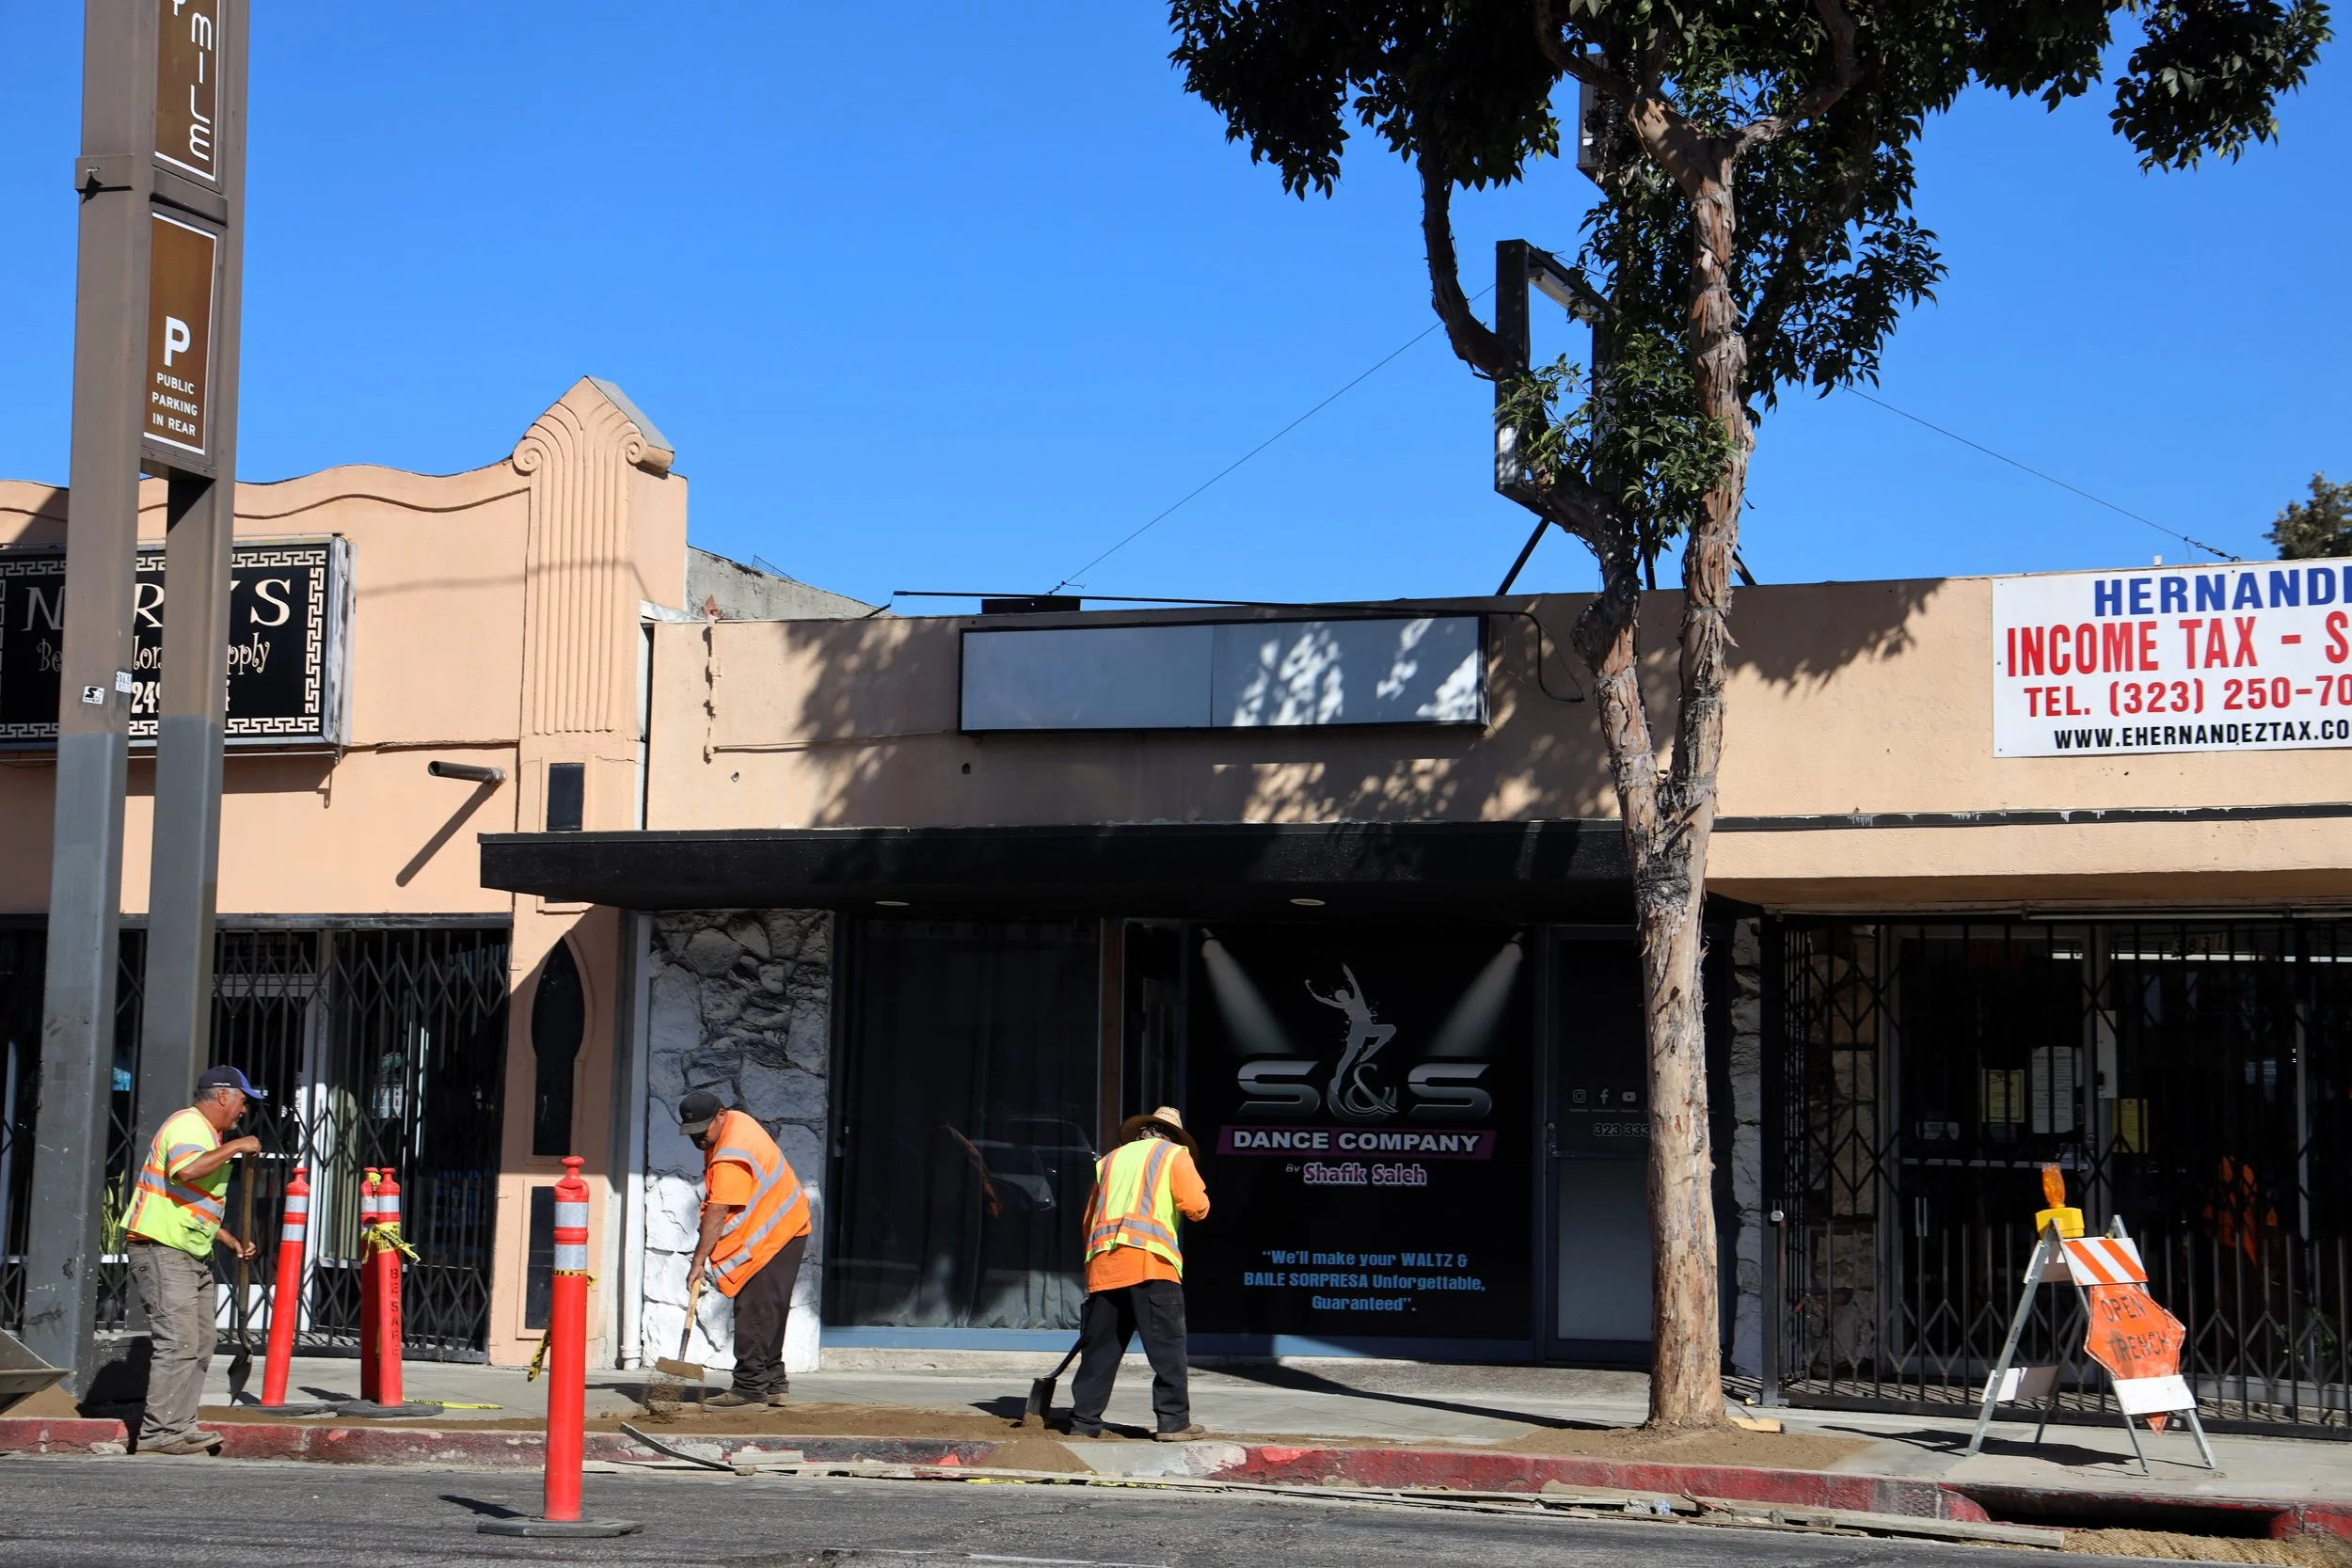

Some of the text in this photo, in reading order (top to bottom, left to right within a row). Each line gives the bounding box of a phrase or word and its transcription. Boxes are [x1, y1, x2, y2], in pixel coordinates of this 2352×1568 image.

[164, 315, 191, 368] P
[156, 372, 196, 395] PUBLIC
[151, 391, 199, 417] PARKING
[152, 412, 197, 436] IN REAR
[2007, 621, 2160, 677] INCOME
[2178, 615, 2259, 670] TAX
[2024, 673, 2352, 718] TEL. (323) 250-70
[1233, 1131, 1481, 1152] DANCE COMPANY
[1593, 1122, 1623, 1137] 323
[1285, 1161, 1428, 1186] By Shafik Saleh
[1311, 1251, 1357, 1266] make
[1359, 1254, 1397, 1268] your
[1401, 1252, 1454, 1268] WALTZ
[1457, 1253, 1469, 1268] &
[1243, 1271, 1286, 1287] BAILE
[1289, 1272, 1369, 1288] SORPRESA
[2100, 1294, 2147, 1323] OPEN
[2106, 1330, 2169, 1364] TRENCH
